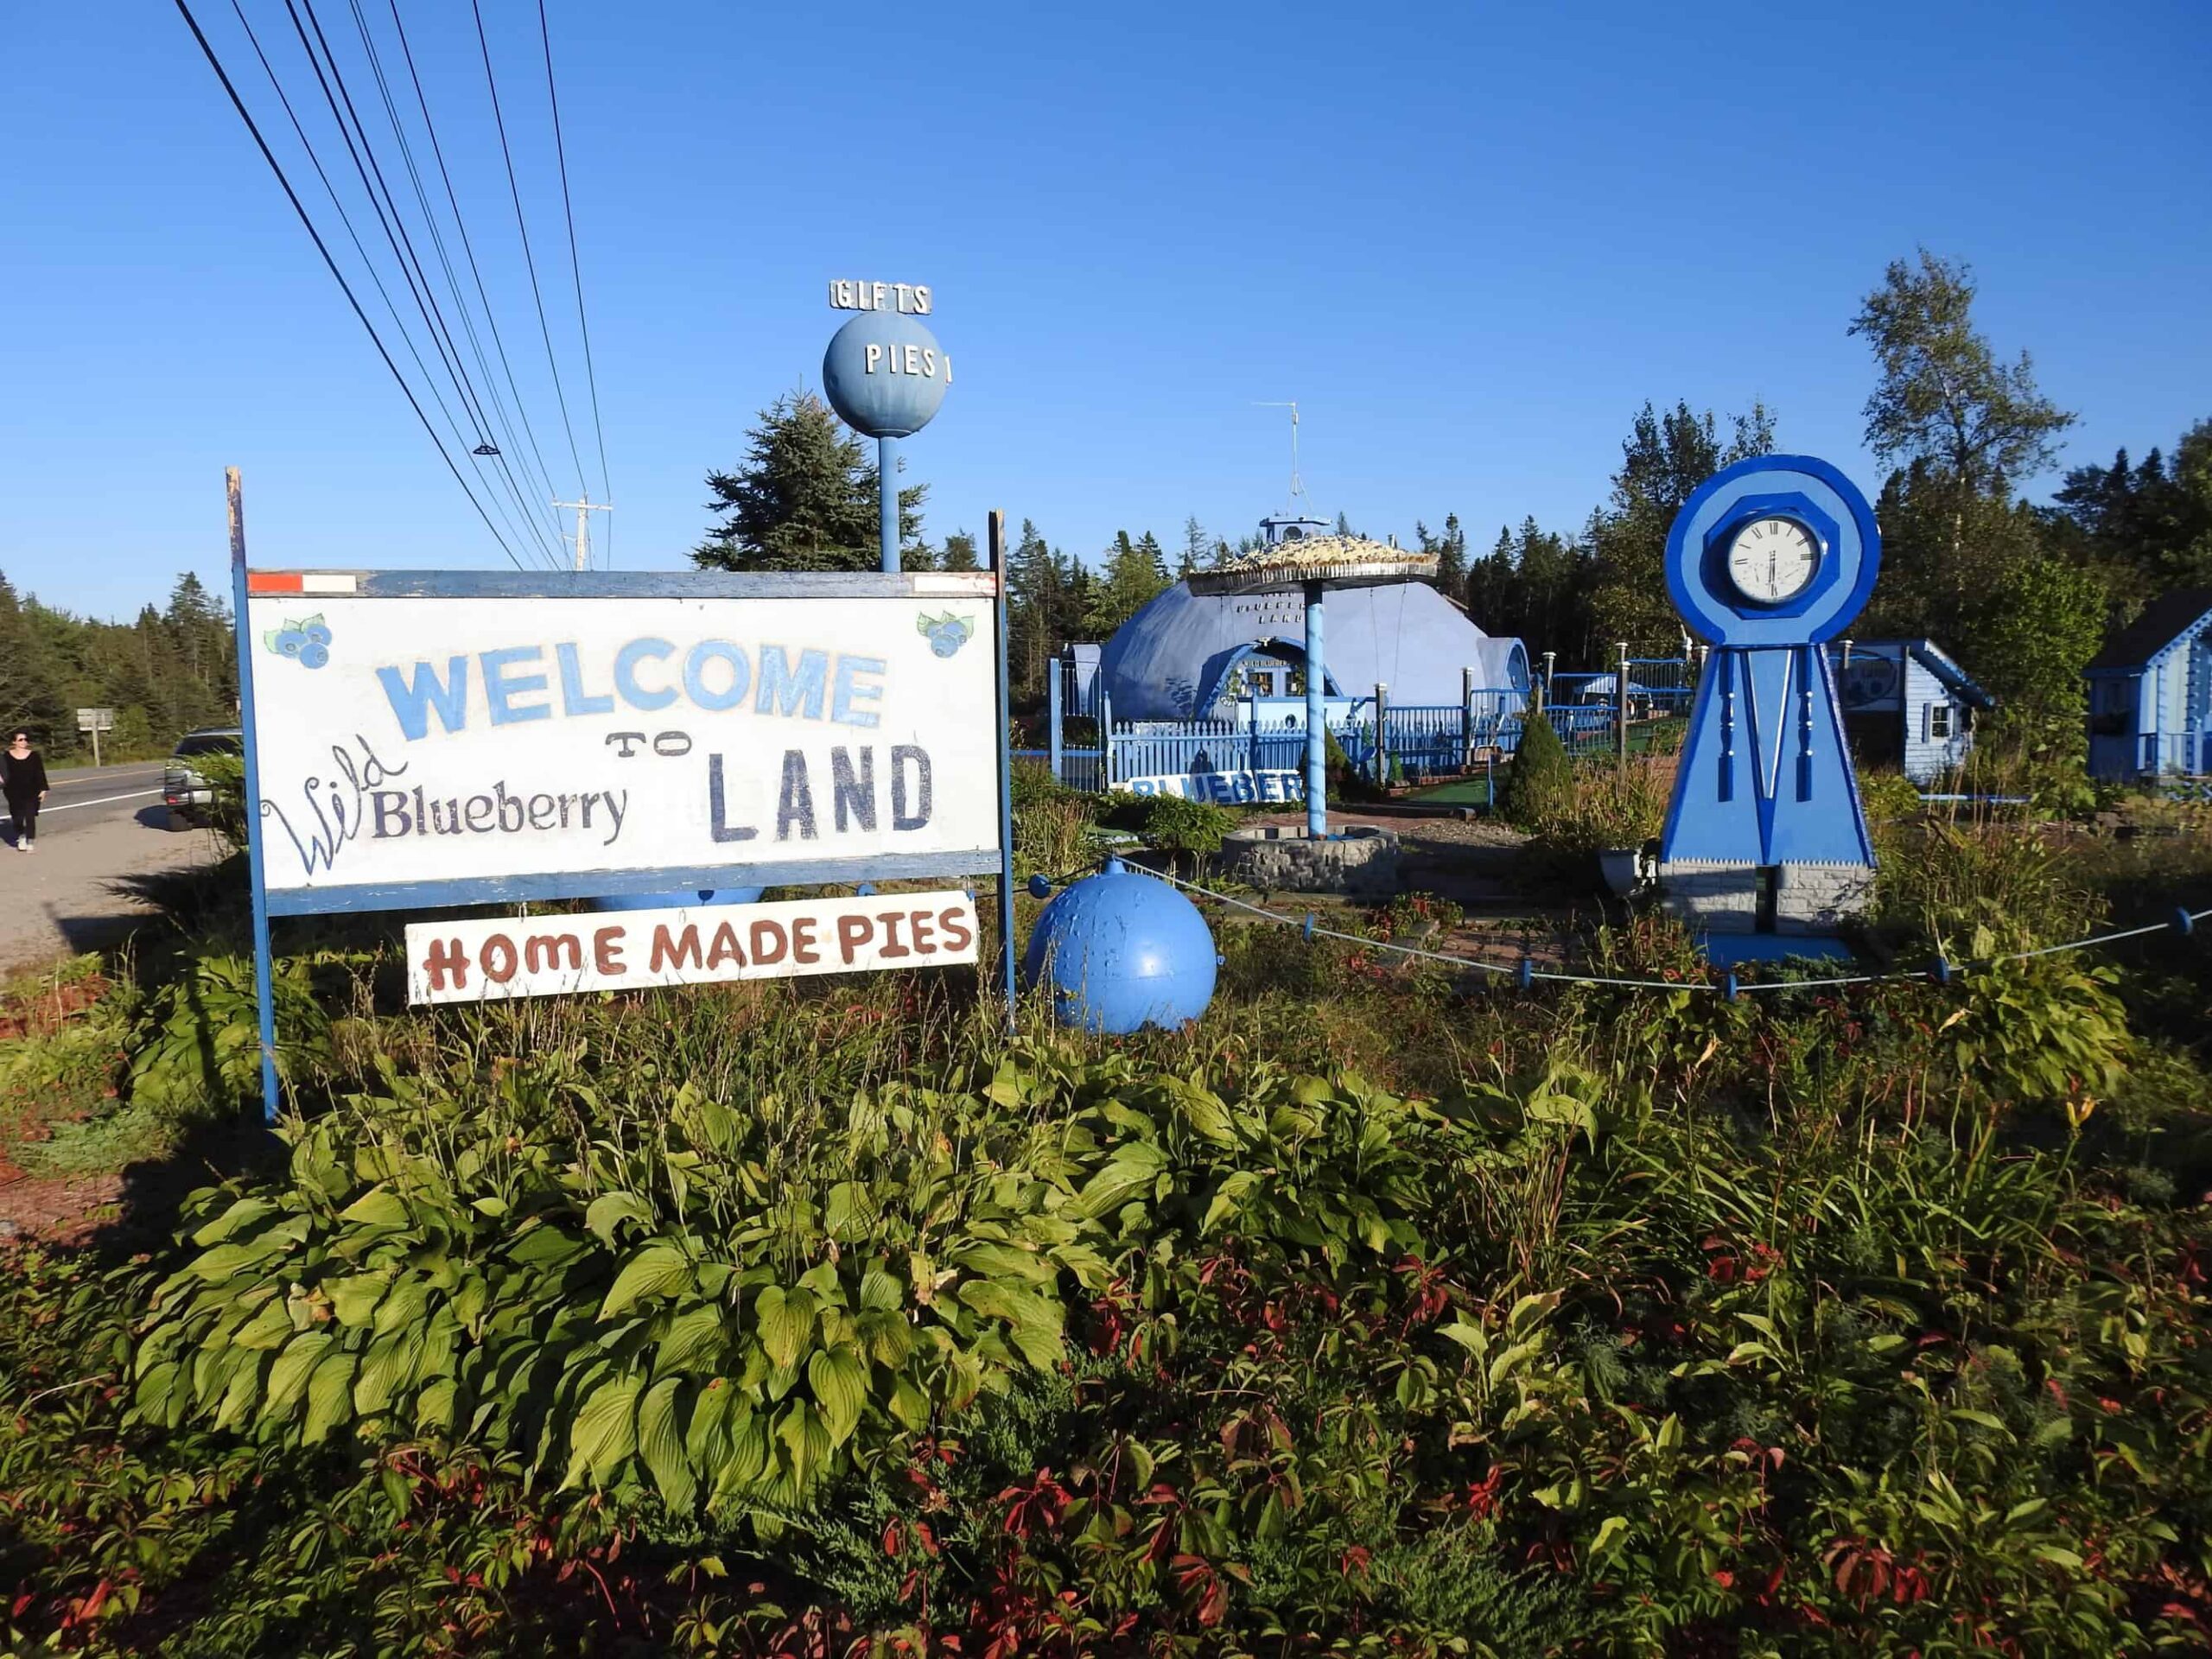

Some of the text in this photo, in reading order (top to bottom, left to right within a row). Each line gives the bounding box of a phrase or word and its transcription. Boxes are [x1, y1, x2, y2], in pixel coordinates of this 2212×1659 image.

[836, 279, 930, 315] GIFTS
[866, 344, 935, 377] PIES
[375, 637, 887, 742] WELCOME
[605, 730, 692, 758] TO
[261, 734, 408, 875] Wild
[371, 745, 932, 845] Blueberry LAND
[649, 918, 821, 974] MADE
[836, 906, 972, 964] PIES
